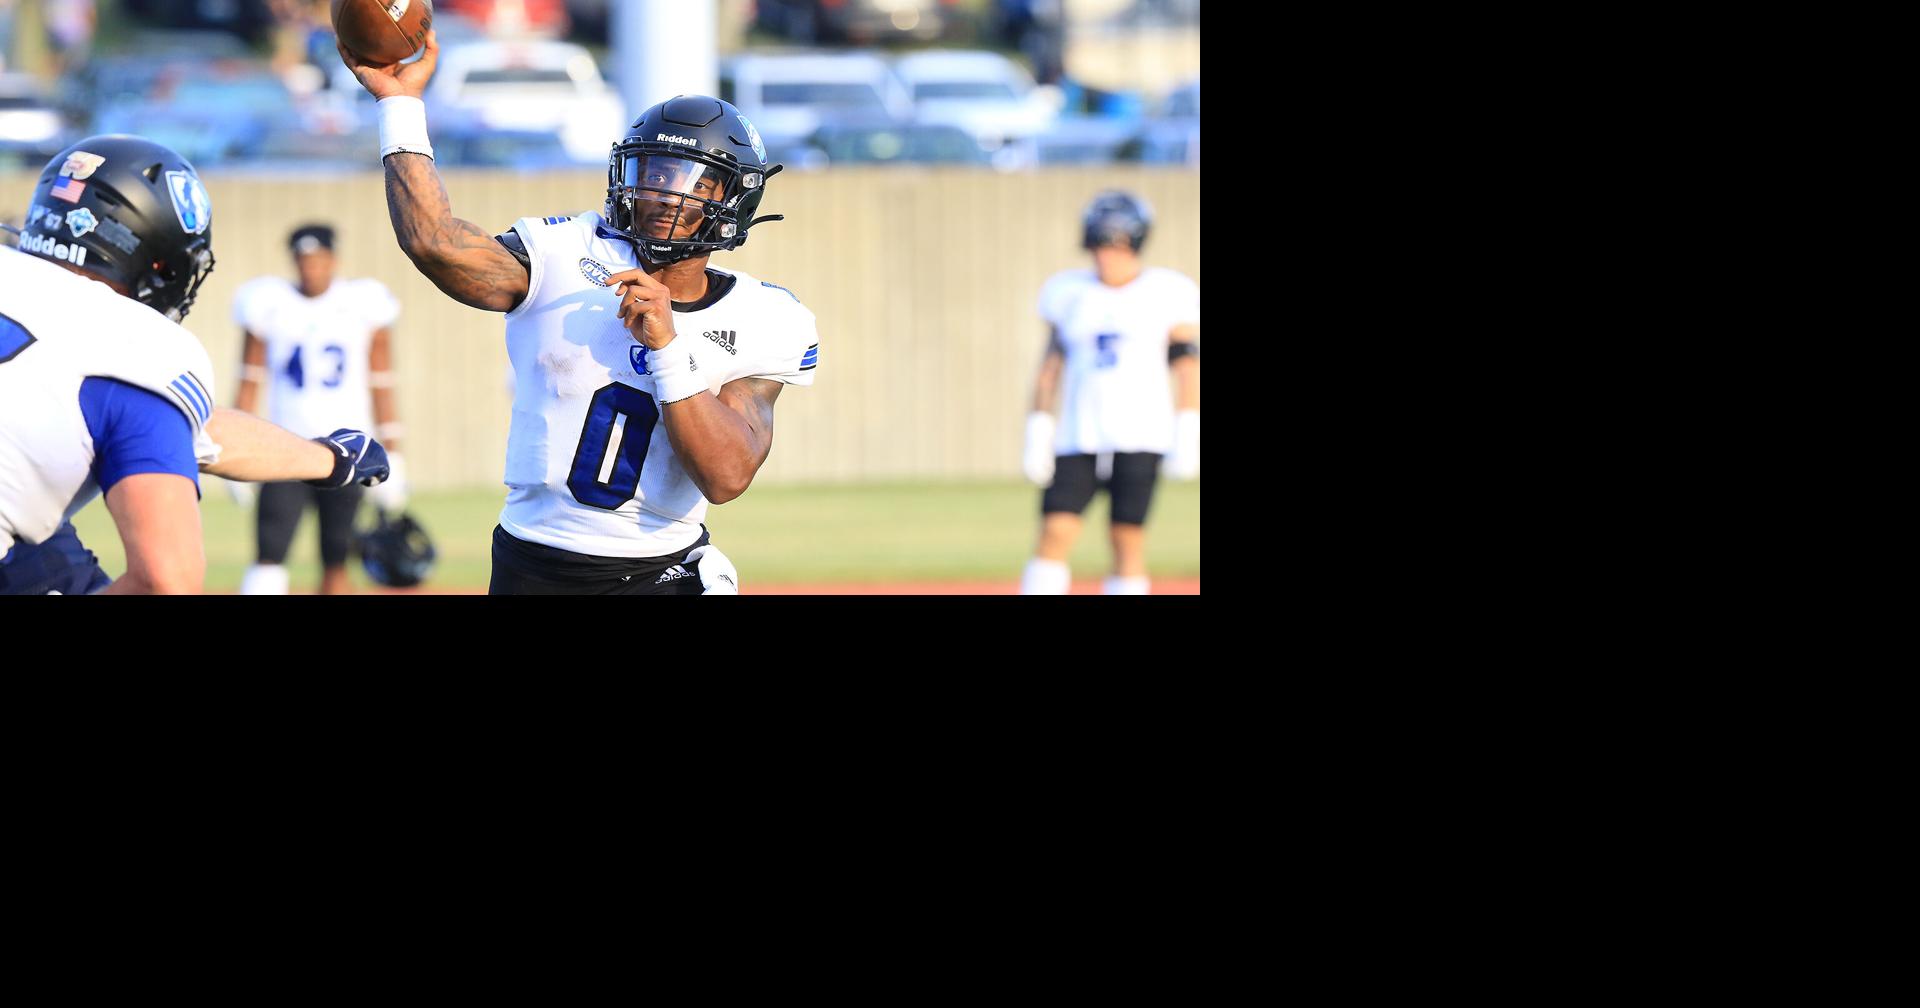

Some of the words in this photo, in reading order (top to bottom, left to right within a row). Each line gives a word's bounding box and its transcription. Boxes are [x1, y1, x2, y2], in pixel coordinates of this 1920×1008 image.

[657, 133, 697, 147] Riddell
[19, 231, 87, 266] Riddell
[702, 331, 737, 356] adidas
[566, 380, 660, 511] 0
